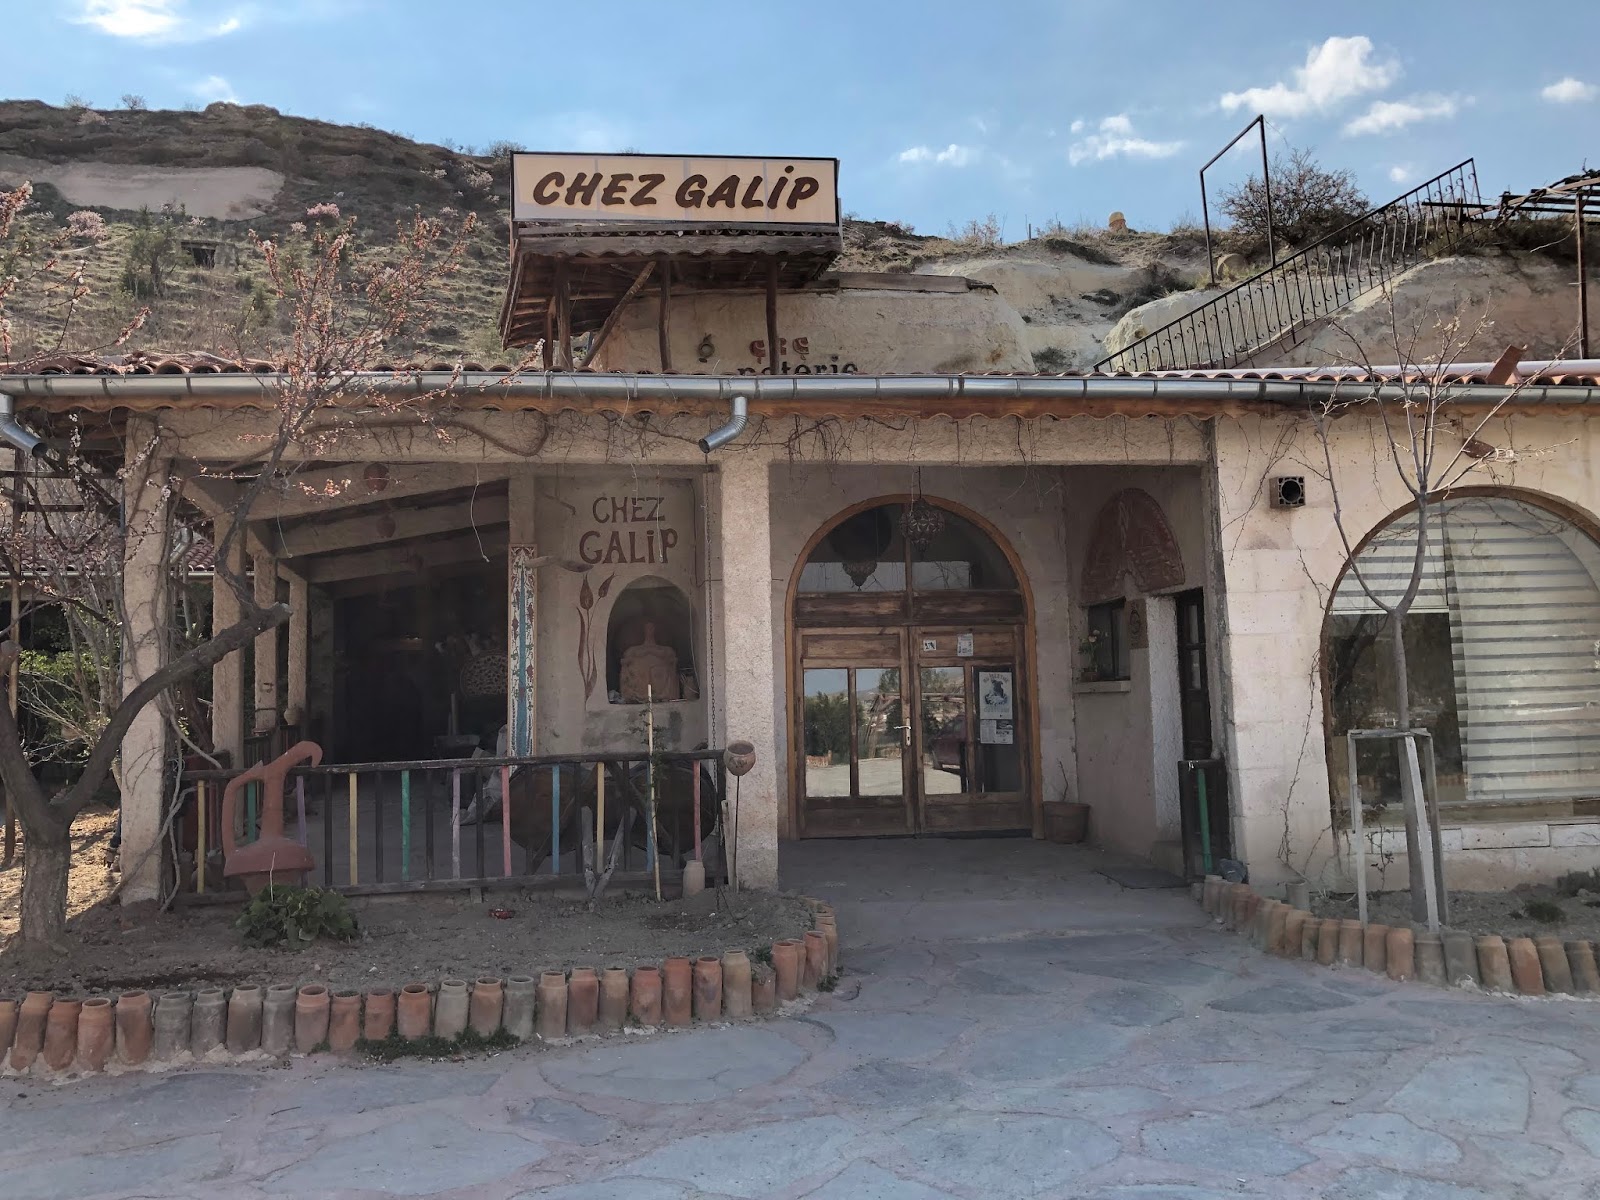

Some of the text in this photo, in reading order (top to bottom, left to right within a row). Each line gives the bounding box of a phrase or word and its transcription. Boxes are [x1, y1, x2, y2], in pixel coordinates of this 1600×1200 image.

[533, 171, 666, 207] CHEZ
[737, 355, 859, 376] terie
[592, 496, 666, 524] CHEZ
